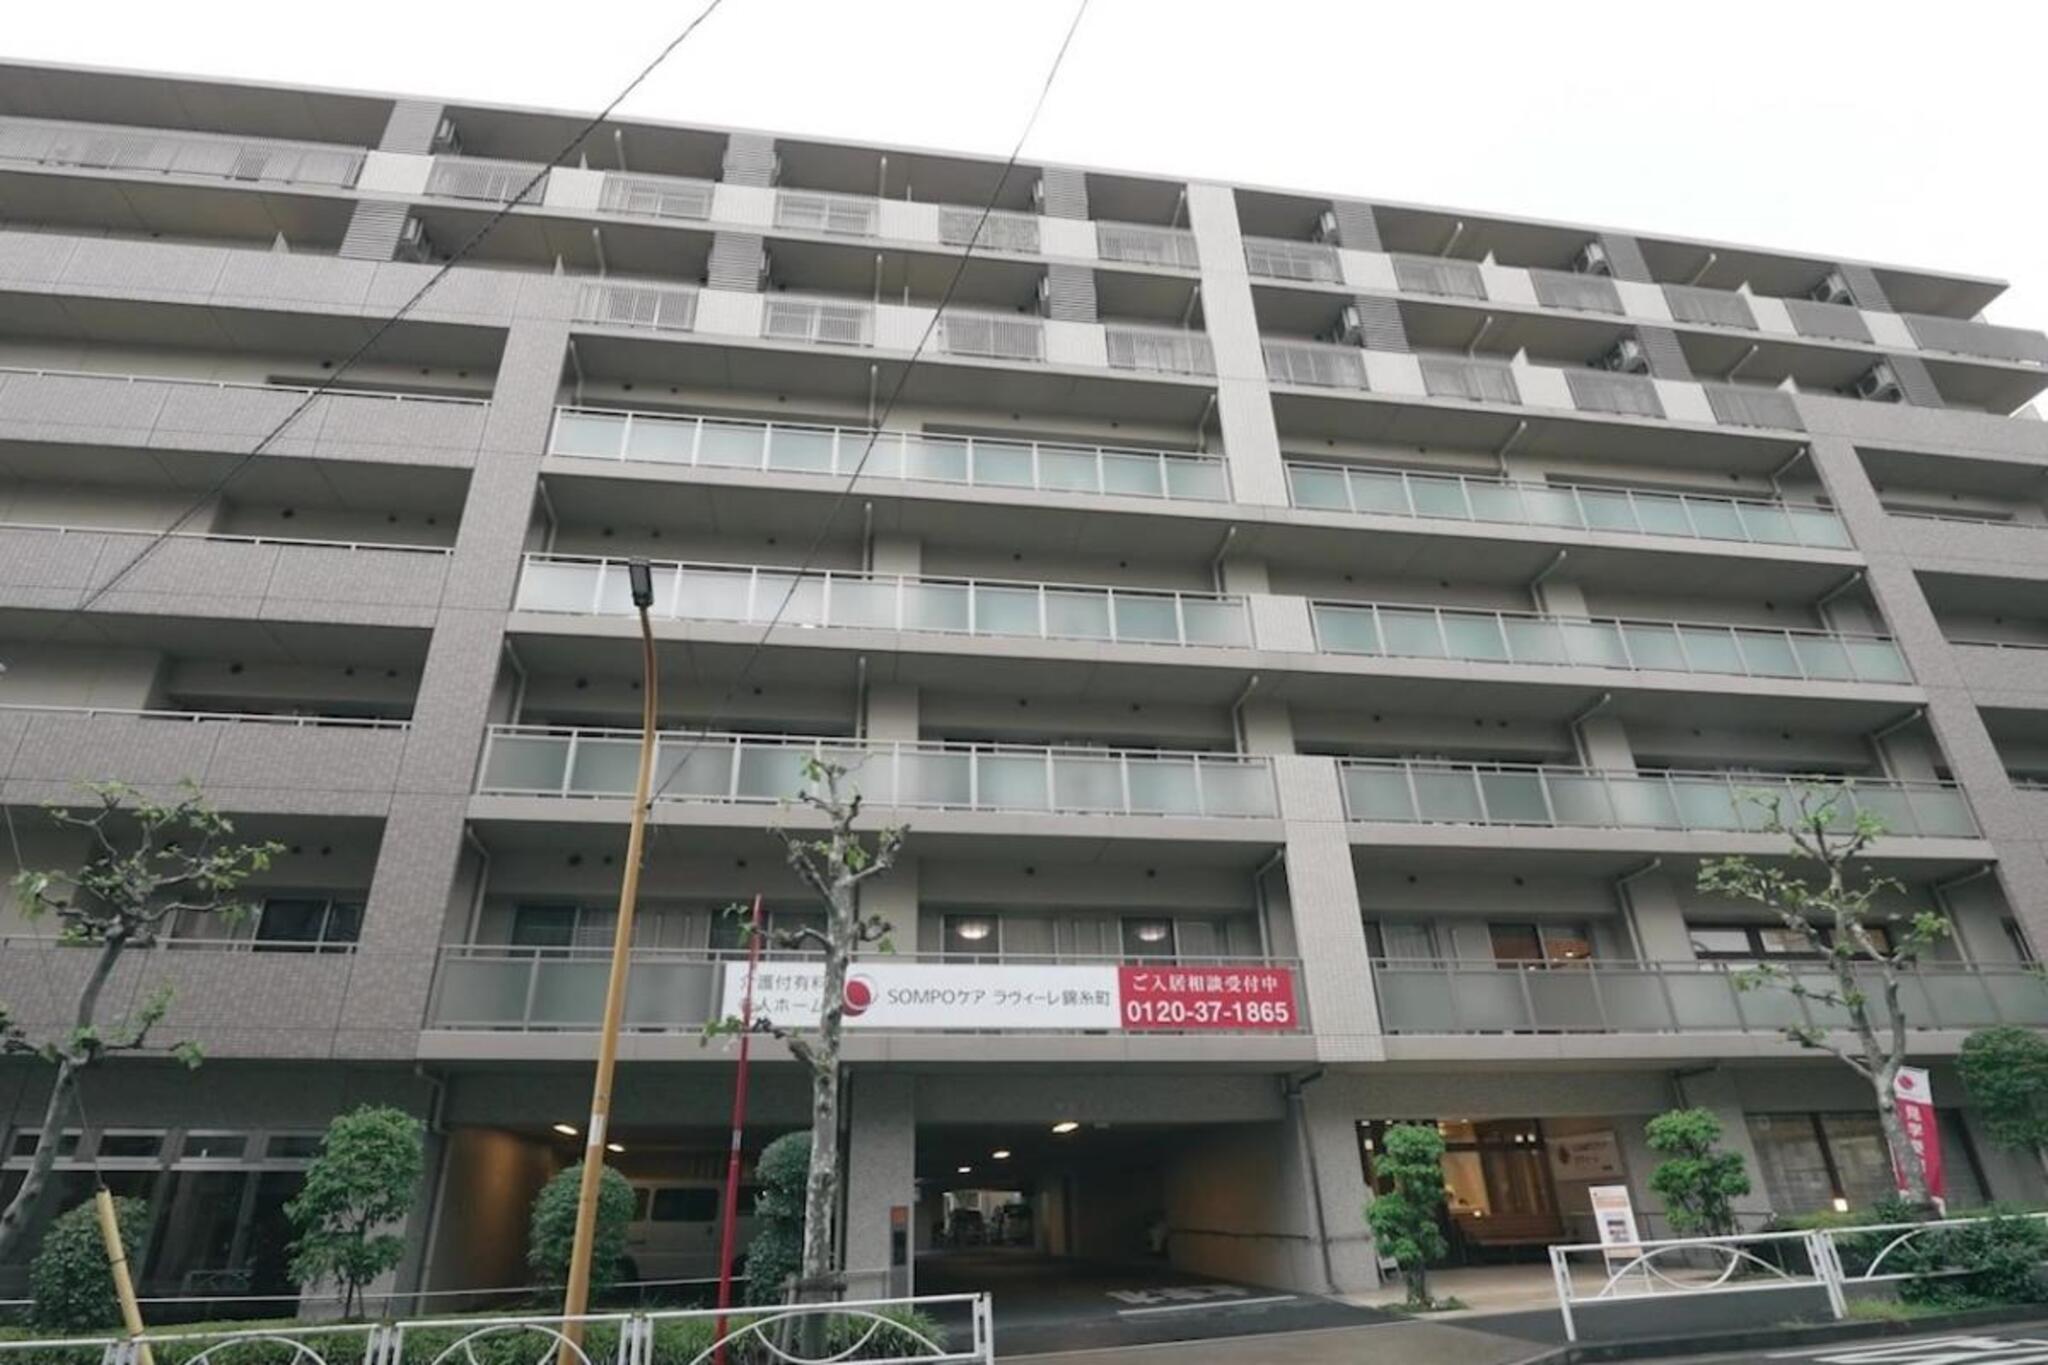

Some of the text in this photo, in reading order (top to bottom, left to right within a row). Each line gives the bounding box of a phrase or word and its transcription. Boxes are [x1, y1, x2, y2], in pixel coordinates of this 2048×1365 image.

[1132, 973, 1278, 993] ご入居相談受付中
[887, 988, 1111, 1007] SOMPOケア ラヴィーレ錦糸町
[1126, 1000, 1289, 1023] 0120-37-1865
